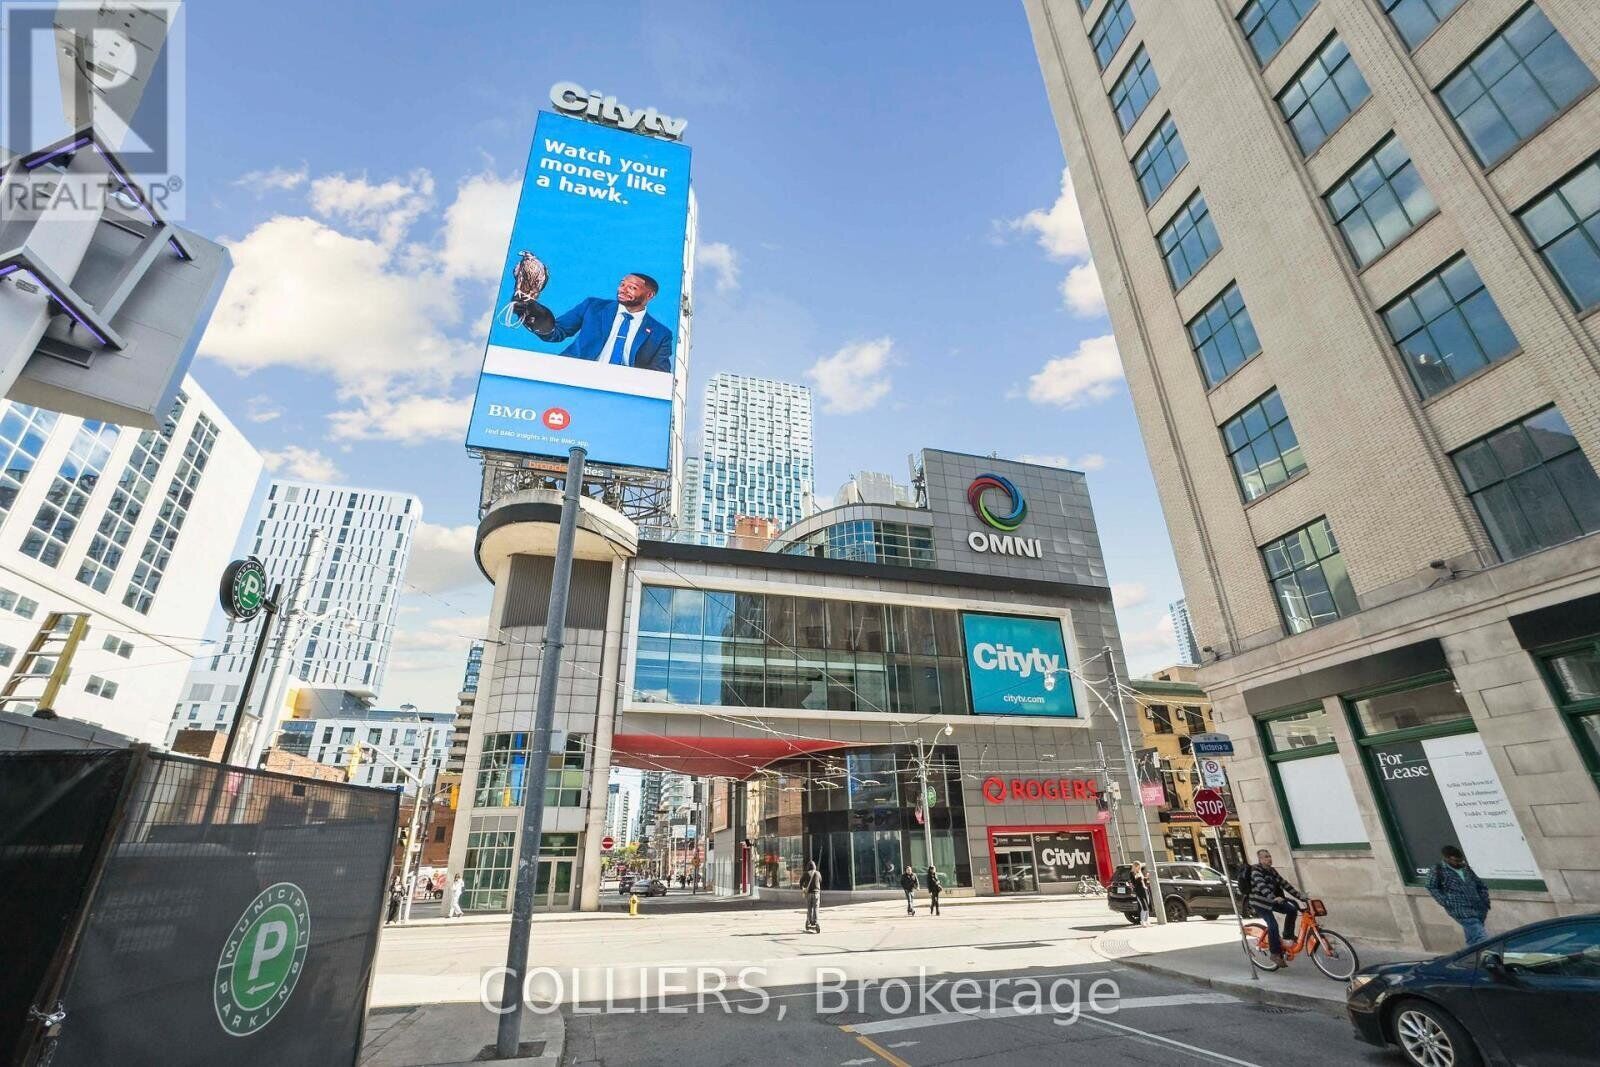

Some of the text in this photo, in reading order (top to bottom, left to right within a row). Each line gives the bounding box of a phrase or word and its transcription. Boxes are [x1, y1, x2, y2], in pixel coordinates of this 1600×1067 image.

[549, 81, 688, 137] Citytv
[544, 138, 668, 179] Watch your
[536, 174, 629, 205] a hawk.
[540, 156, 667, 195] money like
[487, 404, 537, 421] BMO
[967, 531, 1043, 559] OMNI
[973, 642, 1060, 678] Citytv
[1003, 693, 1045, 704] citytv.com
[1376, 751, 1403, 767] For
[1381, 763, 1430, 781] Lease
[1010, 778, 1098, 800] ROGERS
[1196, 800, 1223, 815] STOP
[1041, 848, 1091, 869] Citytv
[226, 889, 307, 959] MUNICIPAL
[248, 920, 288, 981] P
[219, 961, 300, 1028] PARKING
